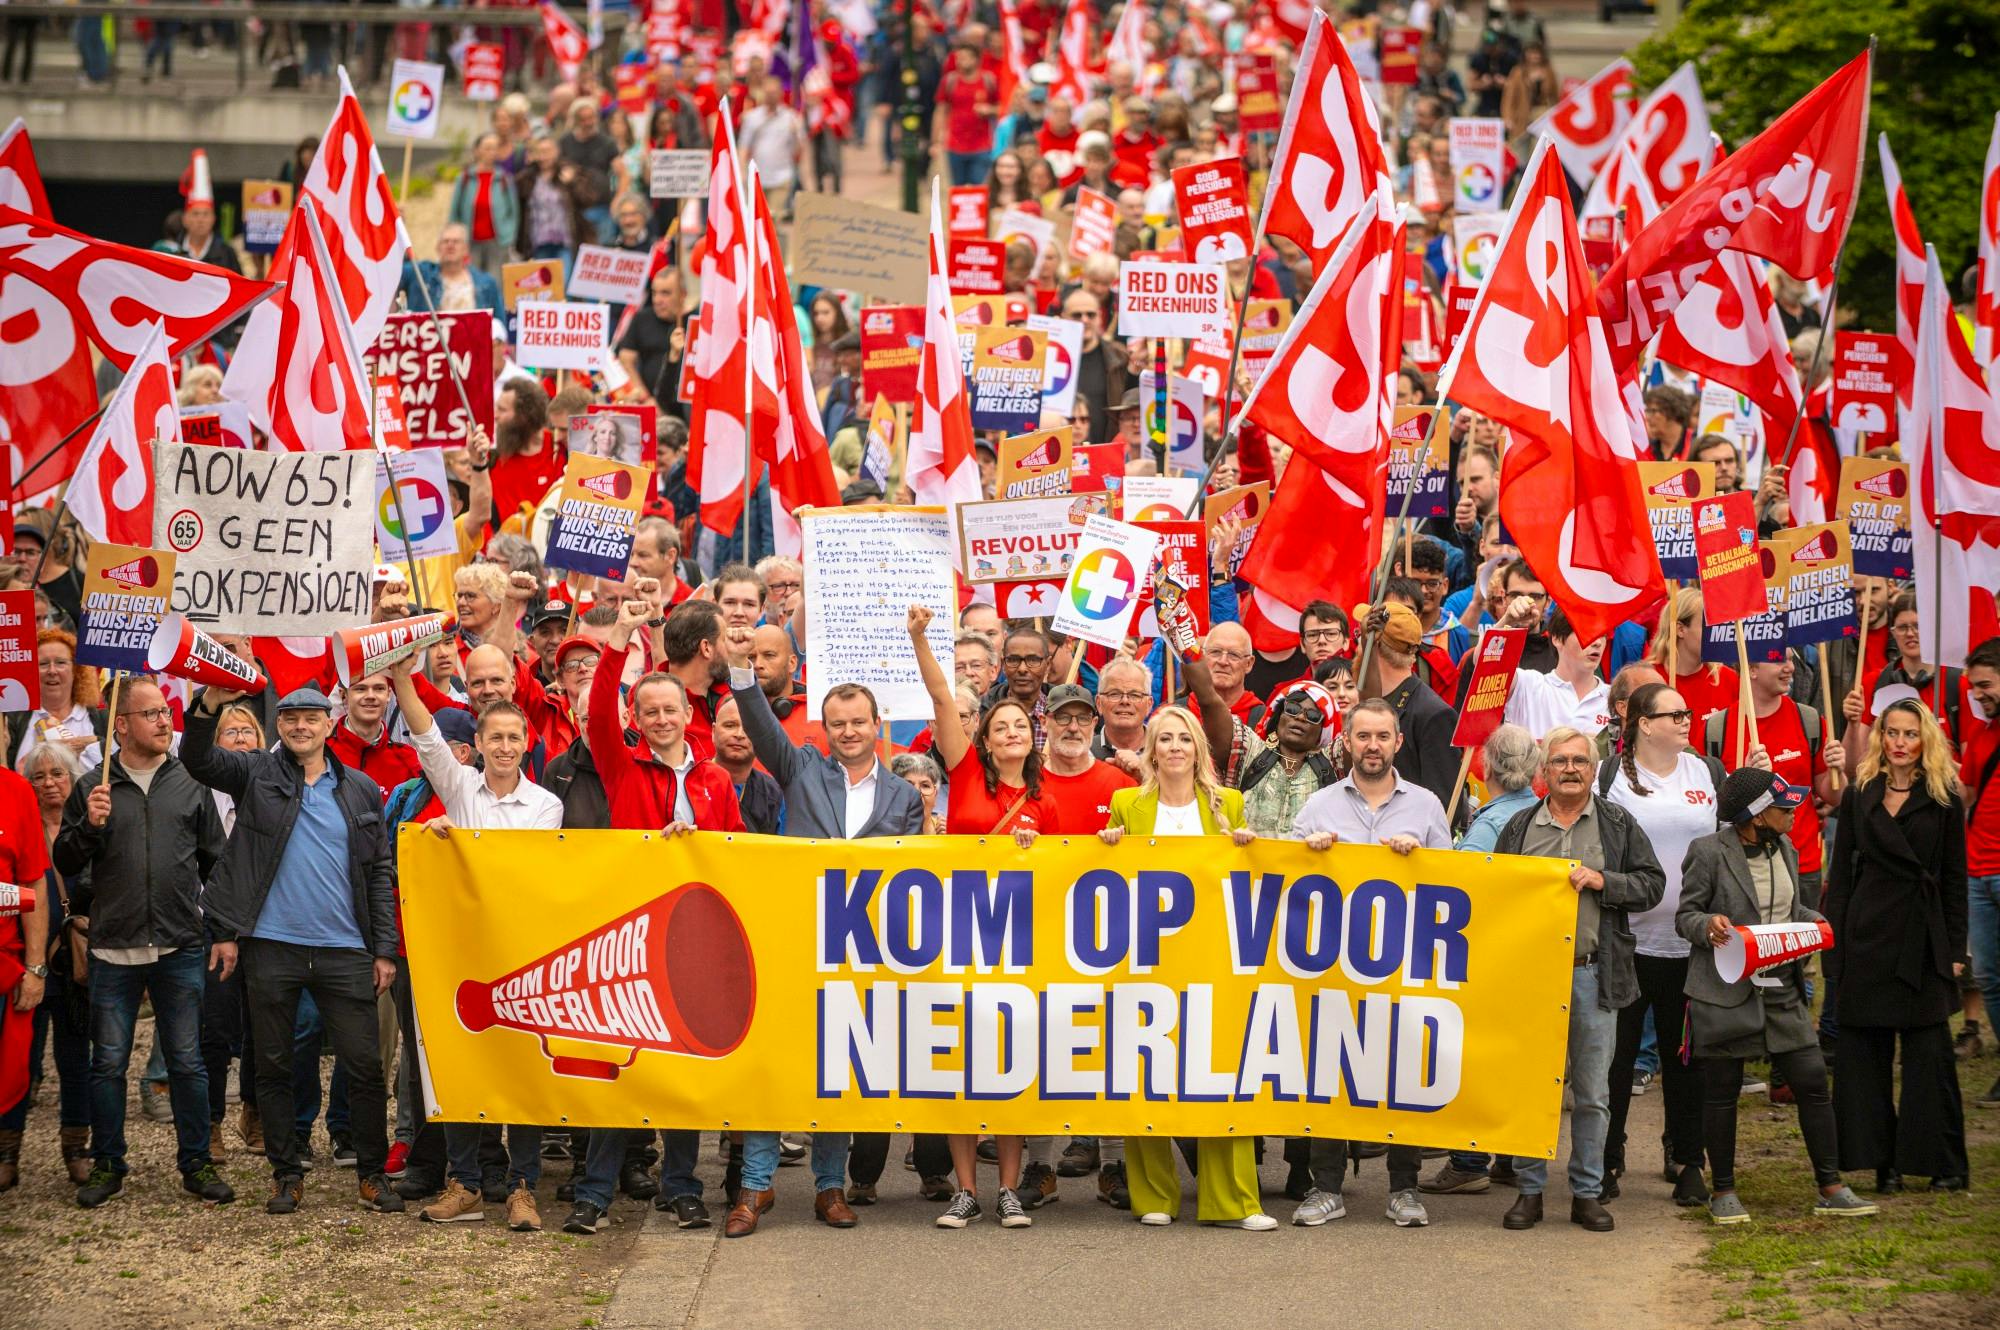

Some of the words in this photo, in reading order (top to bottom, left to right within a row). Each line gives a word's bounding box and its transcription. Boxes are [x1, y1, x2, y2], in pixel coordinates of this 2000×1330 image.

[582, 254, 611, 269] RED
[615, 258, 645, 274] ONS
[1127, 272, 1167, 293] RED
[1175, 273, 1218, 294] ONS
[1127, 296, 1217, 314] ZIEKENHUIS
[523, 310, 558, 329] RED
[565, 311, 602, 330] ONS
[523, 331, 601, 348] ZIEKENHUIS
[976, 367, 1042, 383] ONTEIGEN
[977, 382, 1038, 398] HUISJES-
[976, 397, 1039, 413] MELKERS
[1388, 448, 1409, 463] TA
[175, 447, 276, 502] AOW
[285, 455, 353, 508] 65!
[1006, 468, 1069, 499] ONTEIGEN
[1427, 477, 1446, 493] OV
[560, 499, 637, 525] ONTEIGEN
[1850, 502, 1878, 518] STA
[1881, 503, 1902, 519] OP
[174, 520, 196, 538] 65
[219, 515, 332, 561] GEEN
[560, 517, 632, 541] HUISJES-
[1855, 519, 1895, 536] VOOR
[556, 533, 629, 560] MELKERS
[971, 532, 1082, 556] REVOLUT
[1891, 538, 1913, 553] OV
[1706, 544, 1751, 567] BETAALBARE
[1702, 554, 1758, 580] BOODSCHAPPEN
[1789, 564, 1850, 588] NTEIGEN
[87, 592, 167, 614] ONTEIGEN
[1788, 600, 1853, 628] MELKERS
[85, 629, 152, 650] MELKER
[360, 631, 389, 659] KOM
[391, 627, 407, 648] OP
[410, 619, 442, 640] VOOR
[1710, 621, 1783, 642] MEKERS
[195, 636, 253, 681] MENSEN!
[1476, 673, 1508, 694] LONEN
[1466, 689, 1507, 713] OMHOOG
[816, 868, 1034, 974] KOM
[1065, 869, 1196, 976] OP
[1221, 870, 1472, 991] VOOR
[491, 965, 545, 1002] KOM
[549, 947, 581, 991] OP
[587, 913, 650, 982] VOOR
[492, 979, 672, 1044] NEDERLAND
[816, 980, 1465, 1113] NEDERLAND
